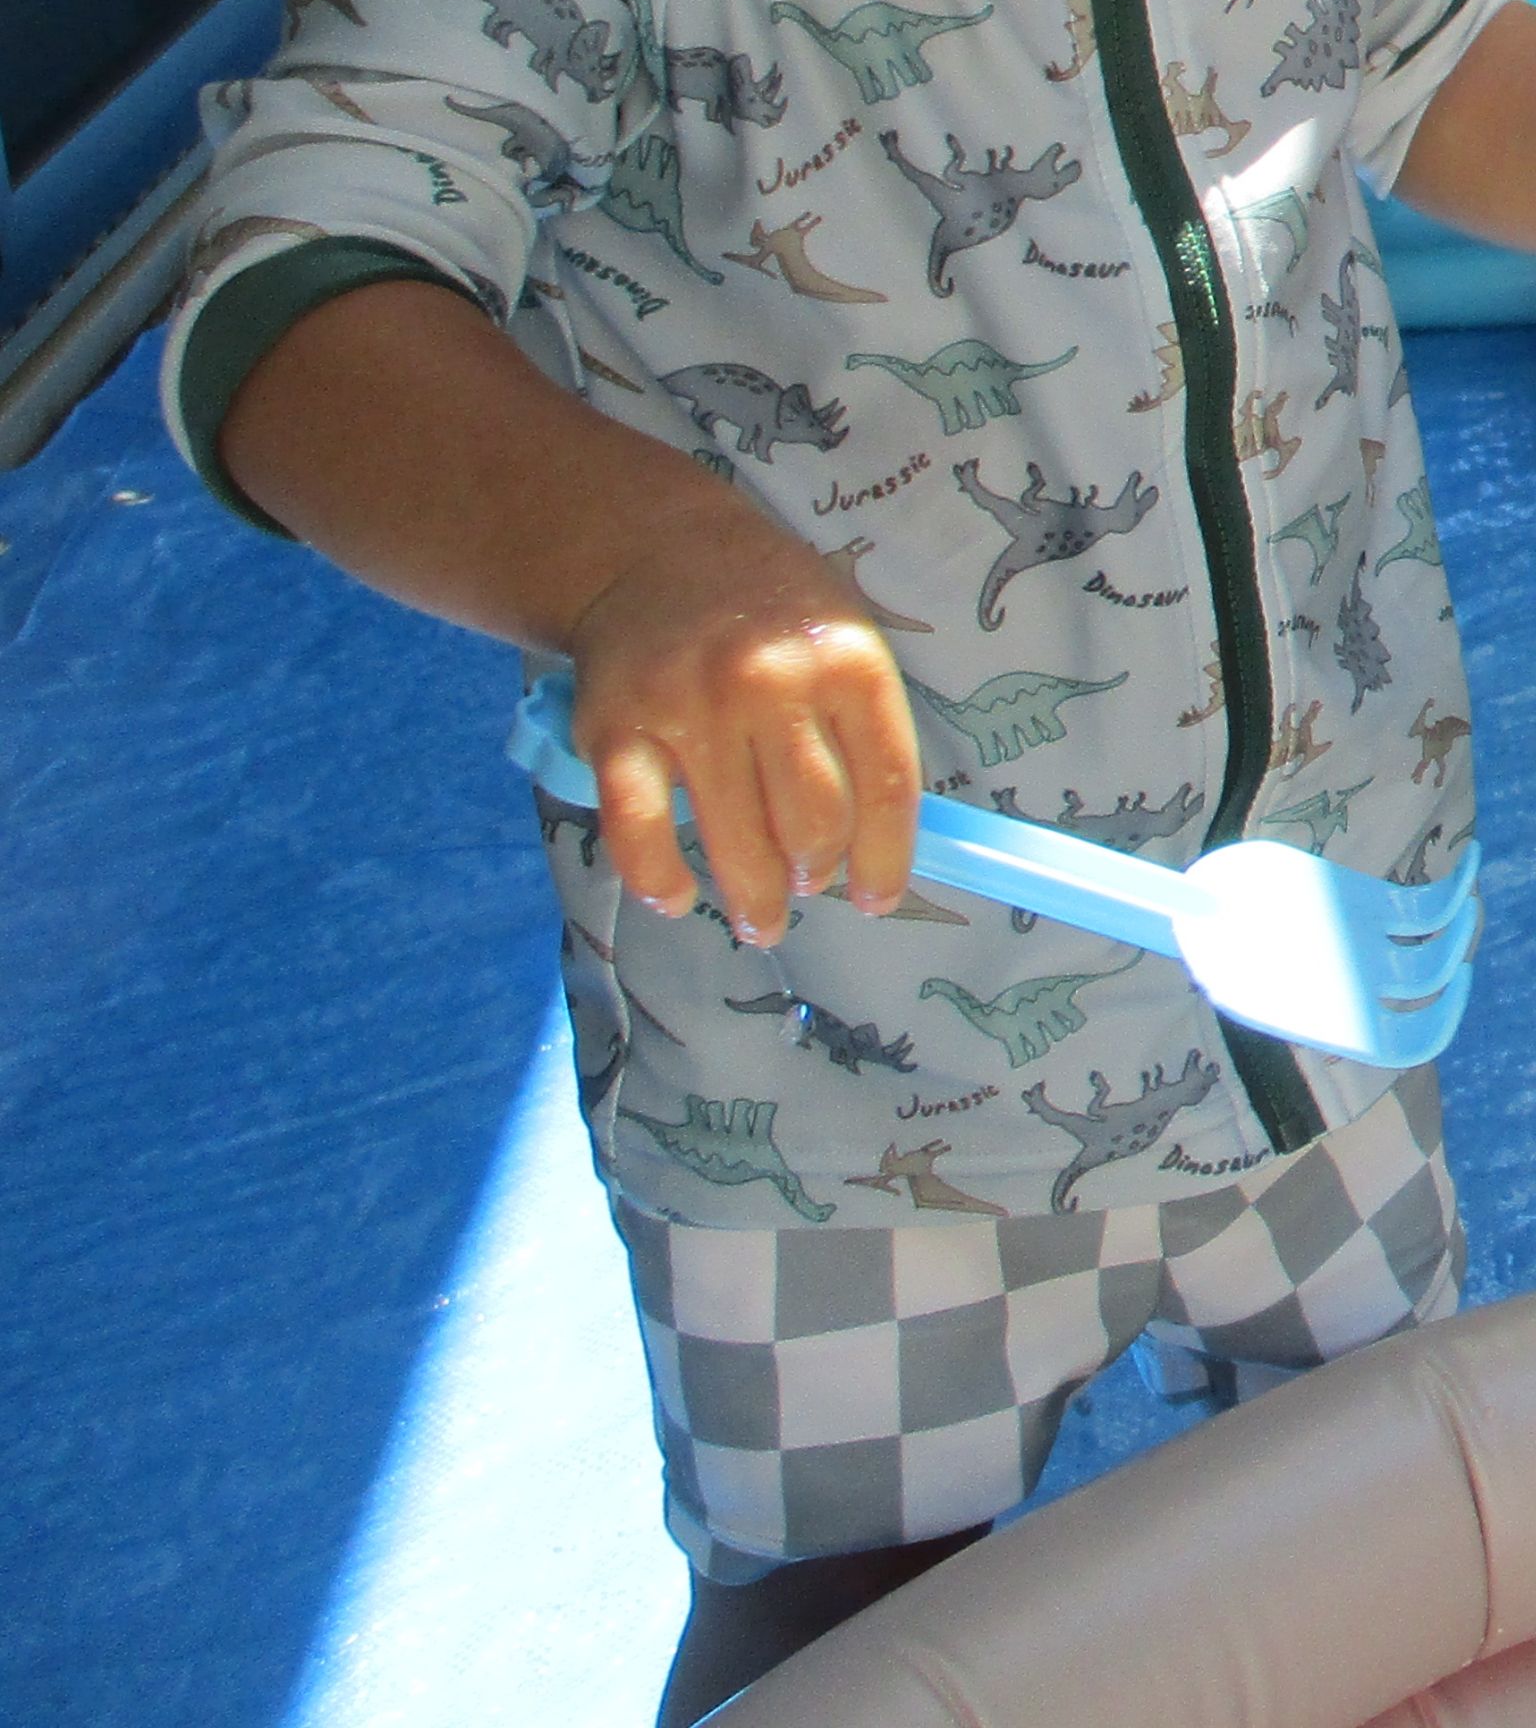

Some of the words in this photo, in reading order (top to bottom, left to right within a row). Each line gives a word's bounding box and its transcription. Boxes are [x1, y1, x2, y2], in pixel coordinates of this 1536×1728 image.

[757, 117, 863, 196] Jurassic
[1022, 238, 1132, 279] Dinosaur
[813, 452, 931, 516] Jurassic
[1081, 570, 1190, 608] Dinosaur
[896, 1084, 1000, 1120] Jurassic
[1158, 1143, 1270, 1175] Dinosaur
